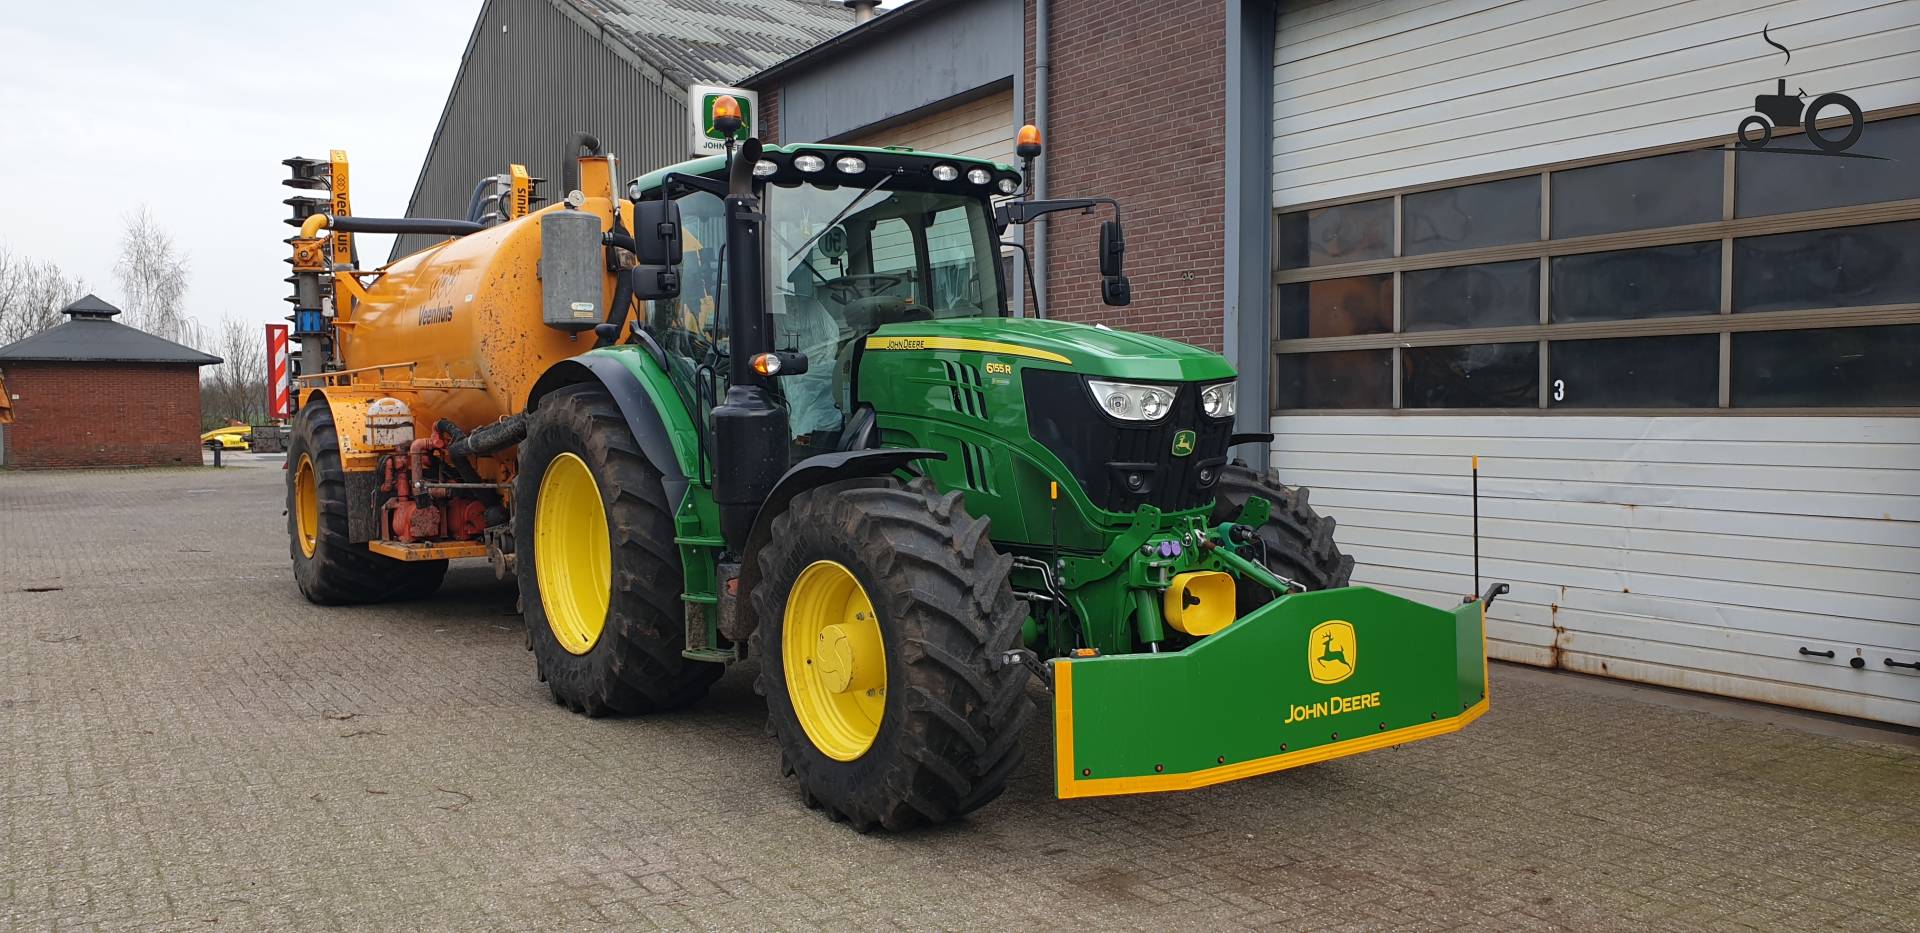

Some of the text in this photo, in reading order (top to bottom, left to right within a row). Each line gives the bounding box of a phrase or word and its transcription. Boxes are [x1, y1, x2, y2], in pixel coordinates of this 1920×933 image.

[703, 142, 725, 150] JOHN
[418, 301, 454, 326] Veenhuis
[887, 339, 925, 348] JOHN DEERE
[1554, 380, 1564, 400] 3
[1285, 692, 1380, 724] JOHN DEERE
